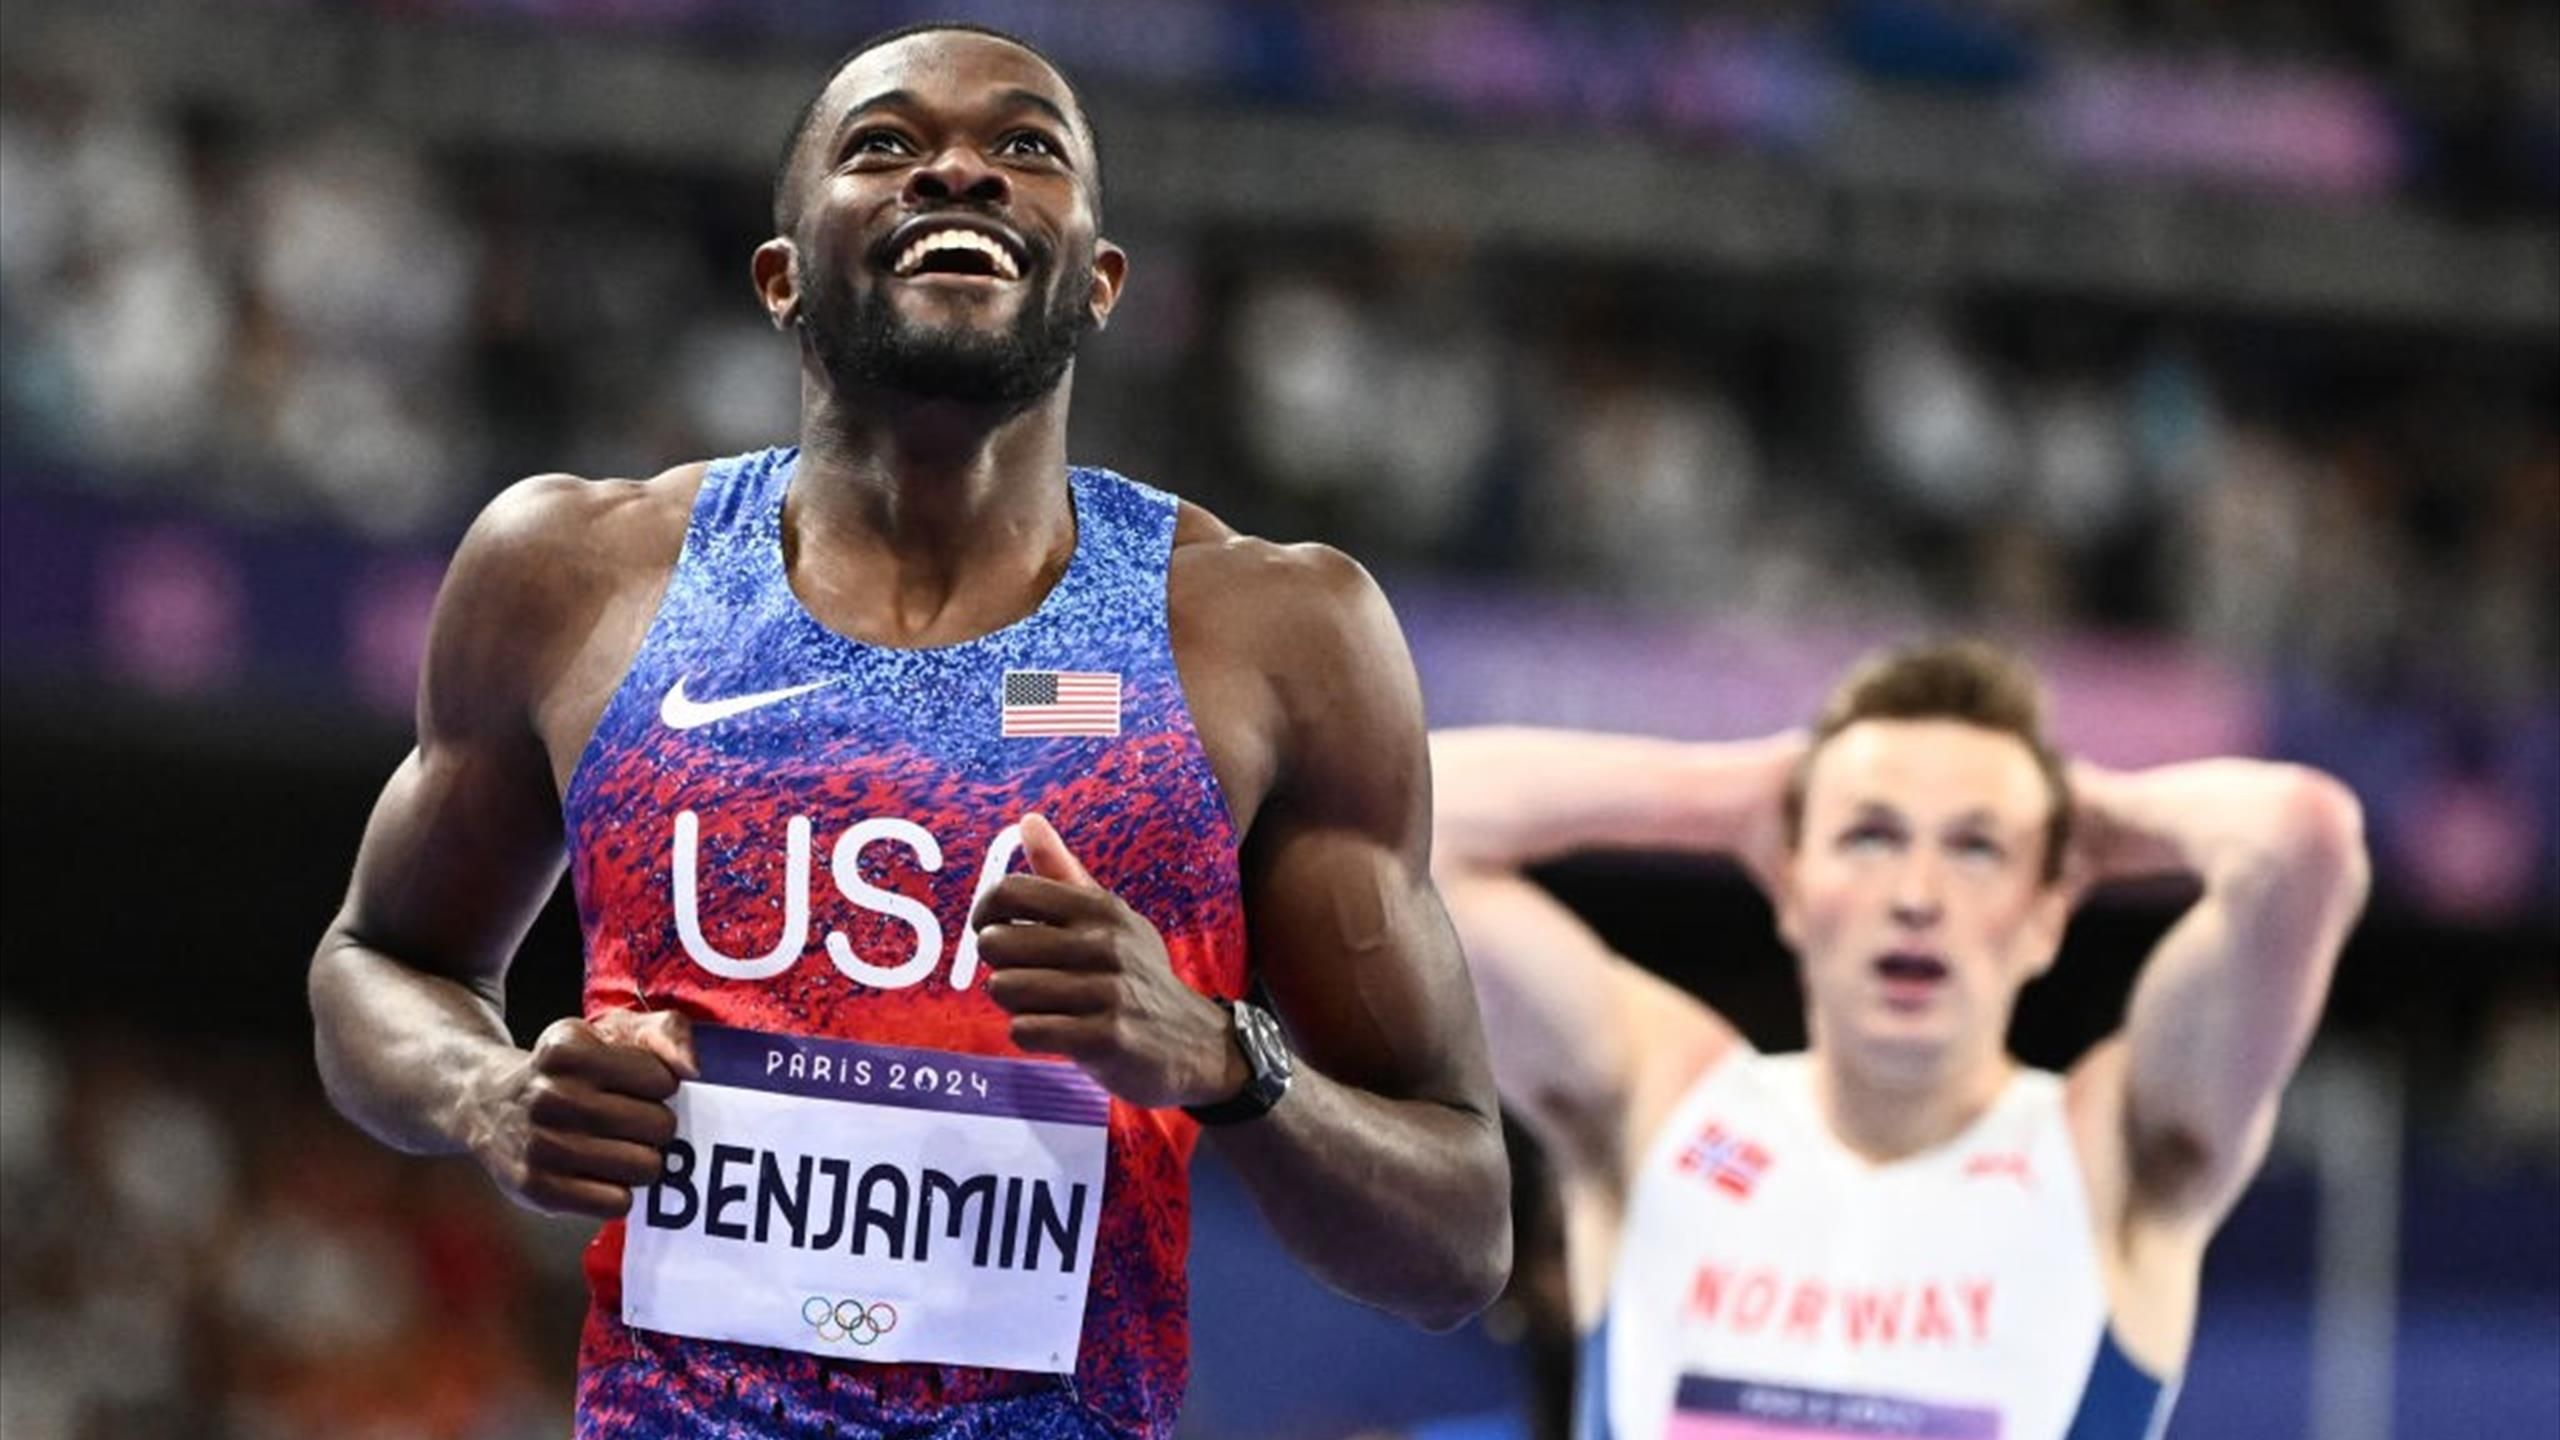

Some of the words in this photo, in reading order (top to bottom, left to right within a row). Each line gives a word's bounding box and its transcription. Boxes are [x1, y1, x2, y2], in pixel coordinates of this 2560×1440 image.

[888, 1063, 988, 1099] 2024
[646, 1139, 1087, 1273] BENJAMIN
[1687, 1265, 1994, 1345] NORWAY
